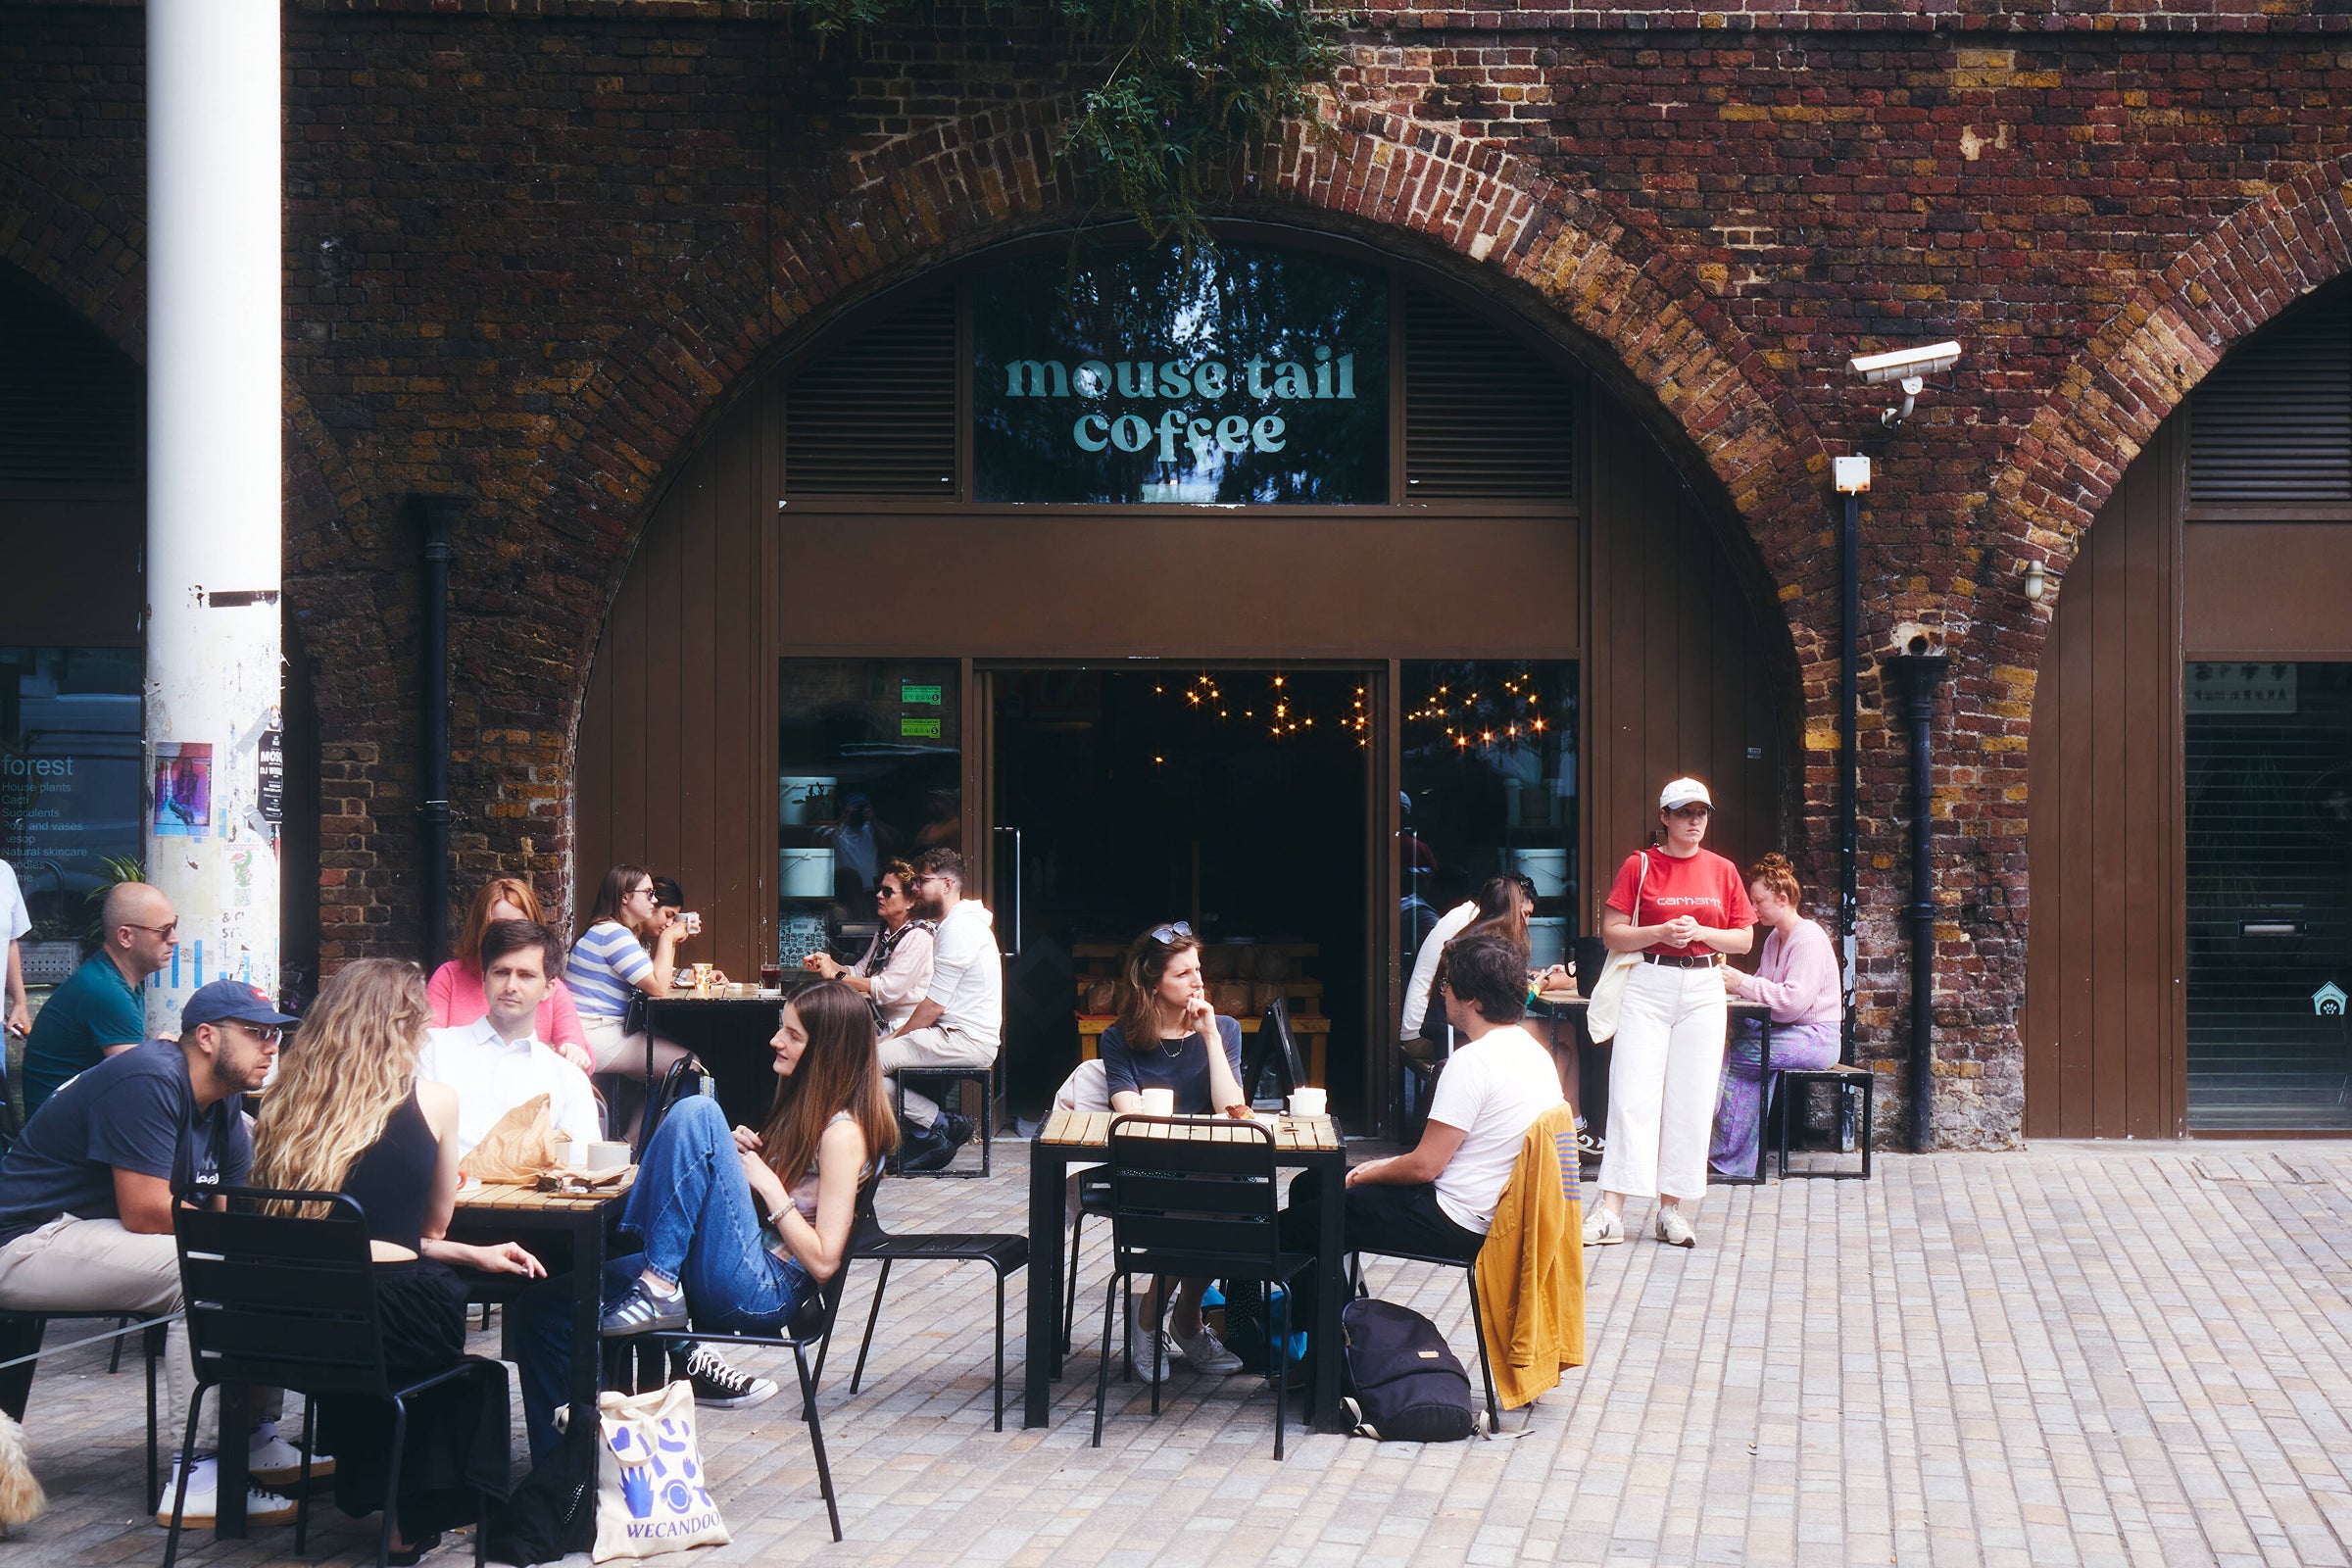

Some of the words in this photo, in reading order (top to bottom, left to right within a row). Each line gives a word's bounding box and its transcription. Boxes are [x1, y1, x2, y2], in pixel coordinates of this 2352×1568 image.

[1004, 360, 1228, 399] mouse
[1243, 345, 1356, 399] tail
[1073, 410, 1287, 472] coffee
[3, 754, 74, 775] forest
[2, 783, 36, 792] House
[40, 782, 72, 794] plants
[2, 795, 29, 805] Cacti
[2, 808, 61, 818] Succulents
[28, 821, 49, 831] and
[2, 847, 40, 857] Natural
[43, 847, 87, 857] skincare
[8, 859, 45, 870] andles
[1657, 896, 1721, 908] carhartt
[627, 1512, 720, 1538] WECANDOO
